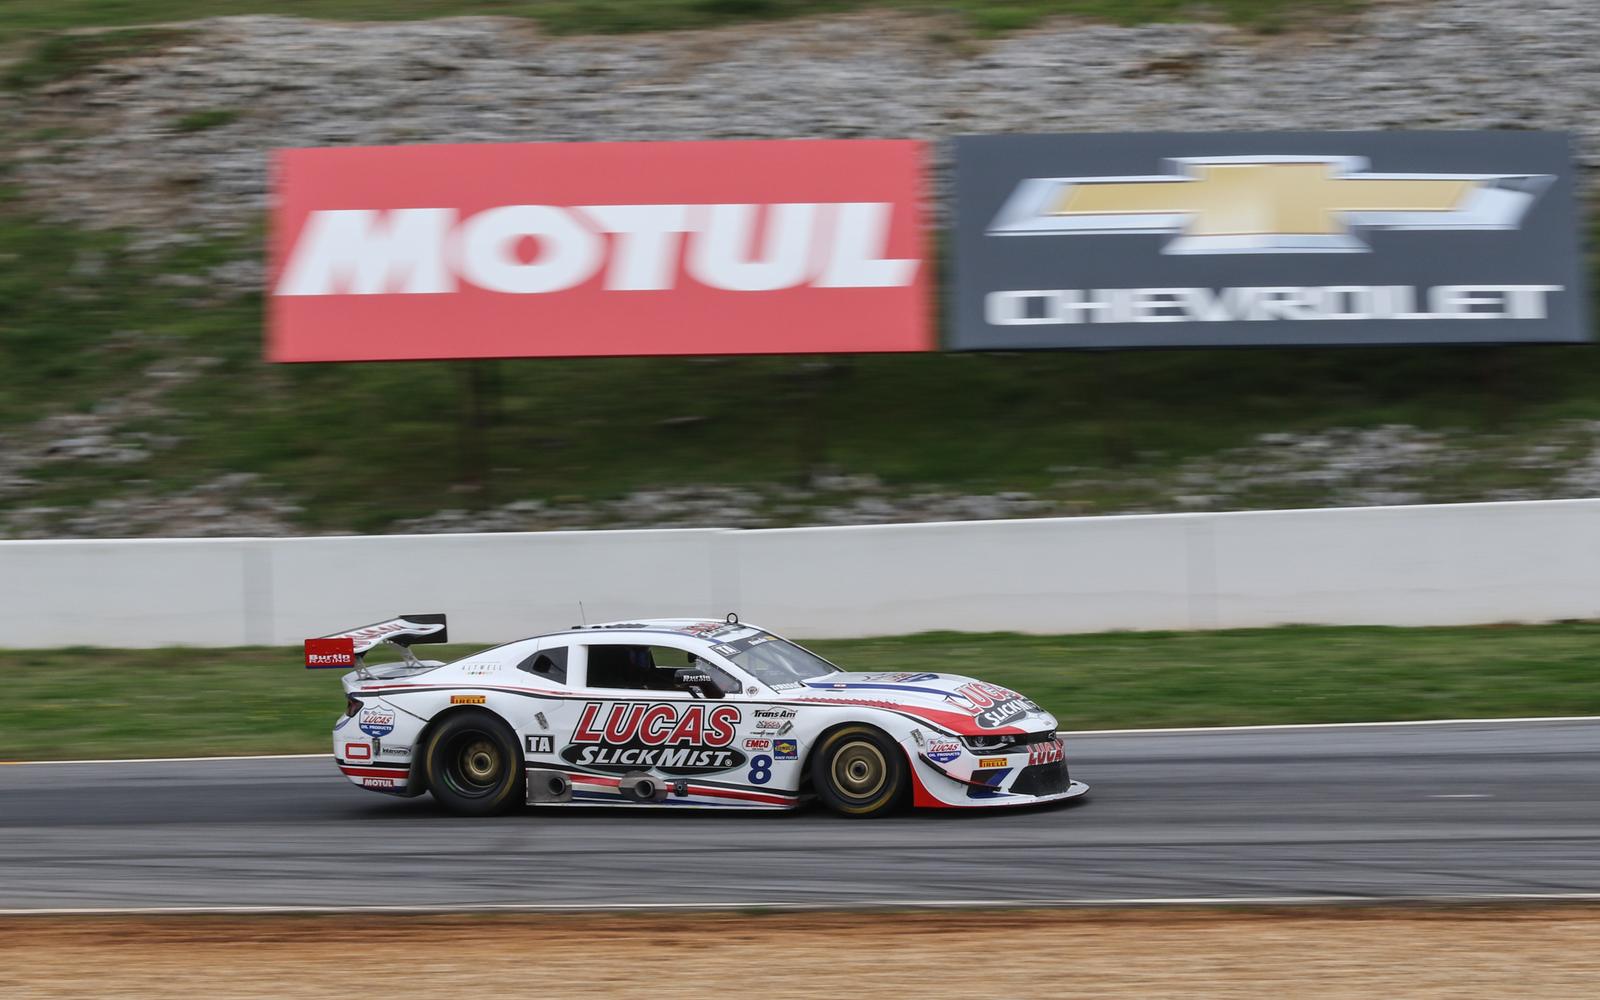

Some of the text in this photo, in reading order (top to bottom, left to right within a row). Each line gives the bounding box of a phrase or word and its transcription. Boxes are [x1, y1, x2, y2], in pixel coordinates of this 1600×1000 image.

[273, 202, 921, 296] MOTUL
[984, 283, 1566, 326] CHEVROLET
[363, 715, 392, 724] LUCAS
[754, 709, 796, 718] Trans Am
[570, 702, 742, 748] LUCAS
[527, 736, 551, 752] TA
[745, 740, 770, 748] EMCO
[930, 743, 960, 752] LUCAS
[747, 754, 773, 785] 8
[364, 778, 393, 787] MOTUL
